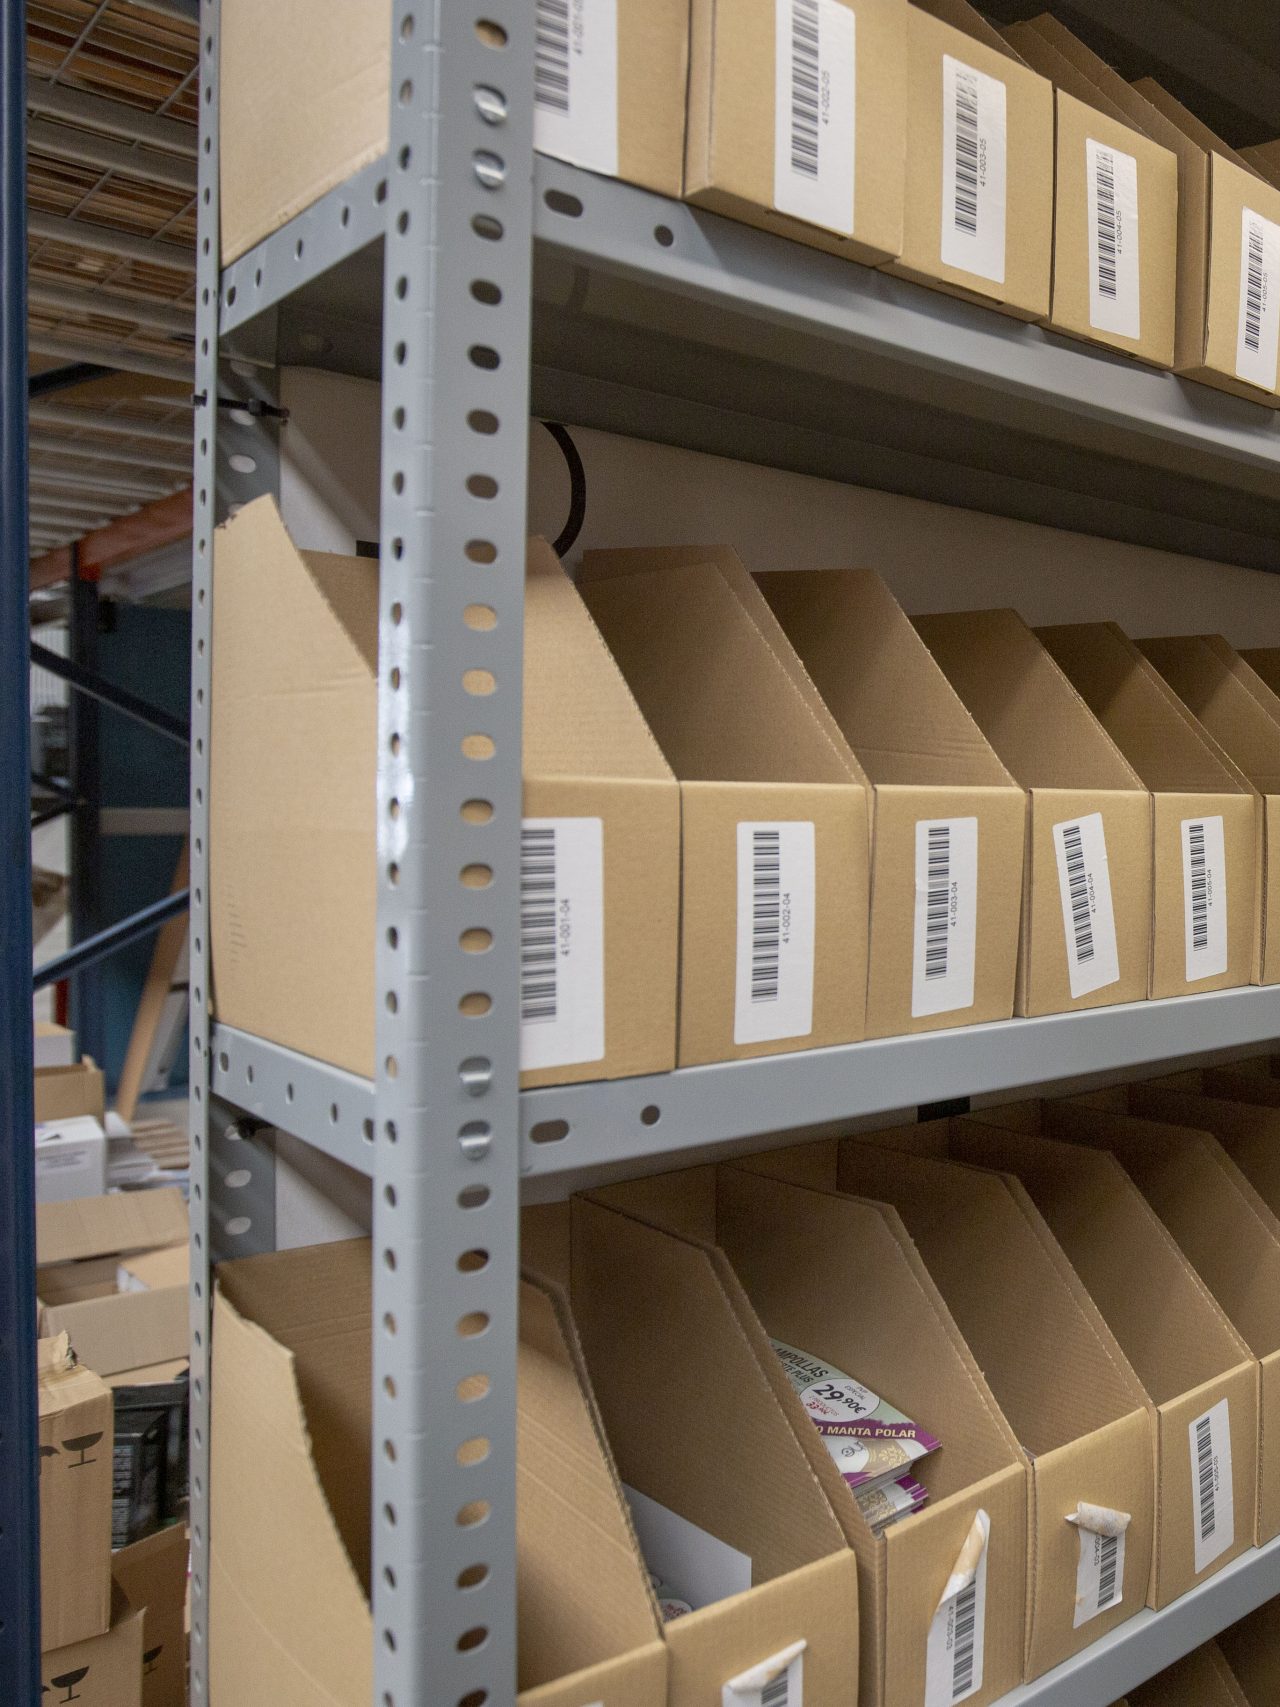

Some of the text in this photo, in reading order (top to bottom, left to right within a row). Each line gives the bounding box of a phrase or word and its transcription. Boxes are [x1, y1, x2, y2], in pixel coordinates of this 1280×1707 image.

[821, 69, 831, 126] 41-002-05
[978, 137, 987, 188] 41-003-05
[1115, 209, 1123, 255] 41-004-05
[1261, 271, 1269, 313] 41-005-05
[950, 881, 958, 927] 41-003-04
[1087, 872, 1097, 914] 41-004-04
[559, 897, 571, 957] 41-001-04
[782, 892, 791, 944] 41-002-04
[794, 1366, 814, 1383] PLUS
[812, 1384, 866, 1414] 29,90€
[827, 1426, 872, 1437] MANTA
[875, 1428, 916, 1439] POLAR
